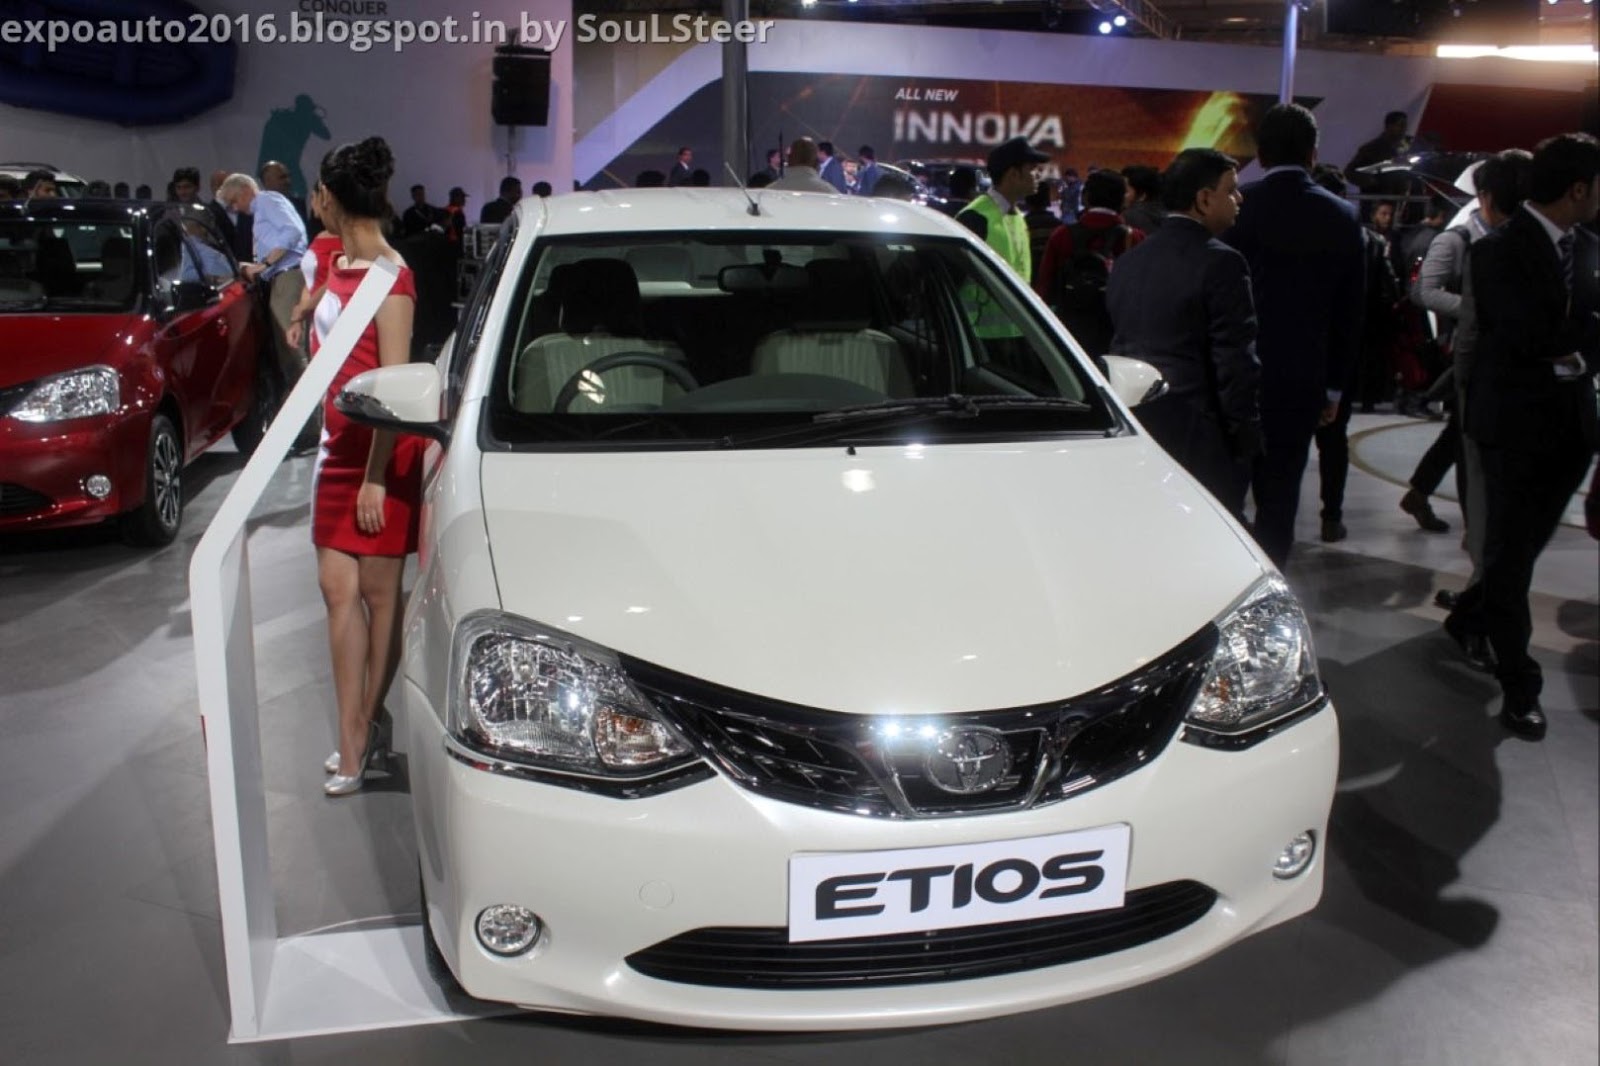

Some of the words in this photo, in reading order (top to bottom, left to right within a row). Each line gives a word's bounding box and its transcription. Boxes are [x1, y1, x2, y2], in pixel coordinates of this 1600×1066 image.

[299, 0, 388, 15] CONQUER
[895, 87, 921, 100] ALL
[925, 89, 958, 101] NEW
[894, 111, 1065, 147] INNOVA
[815, 849, 1105, 920] ETIOS
